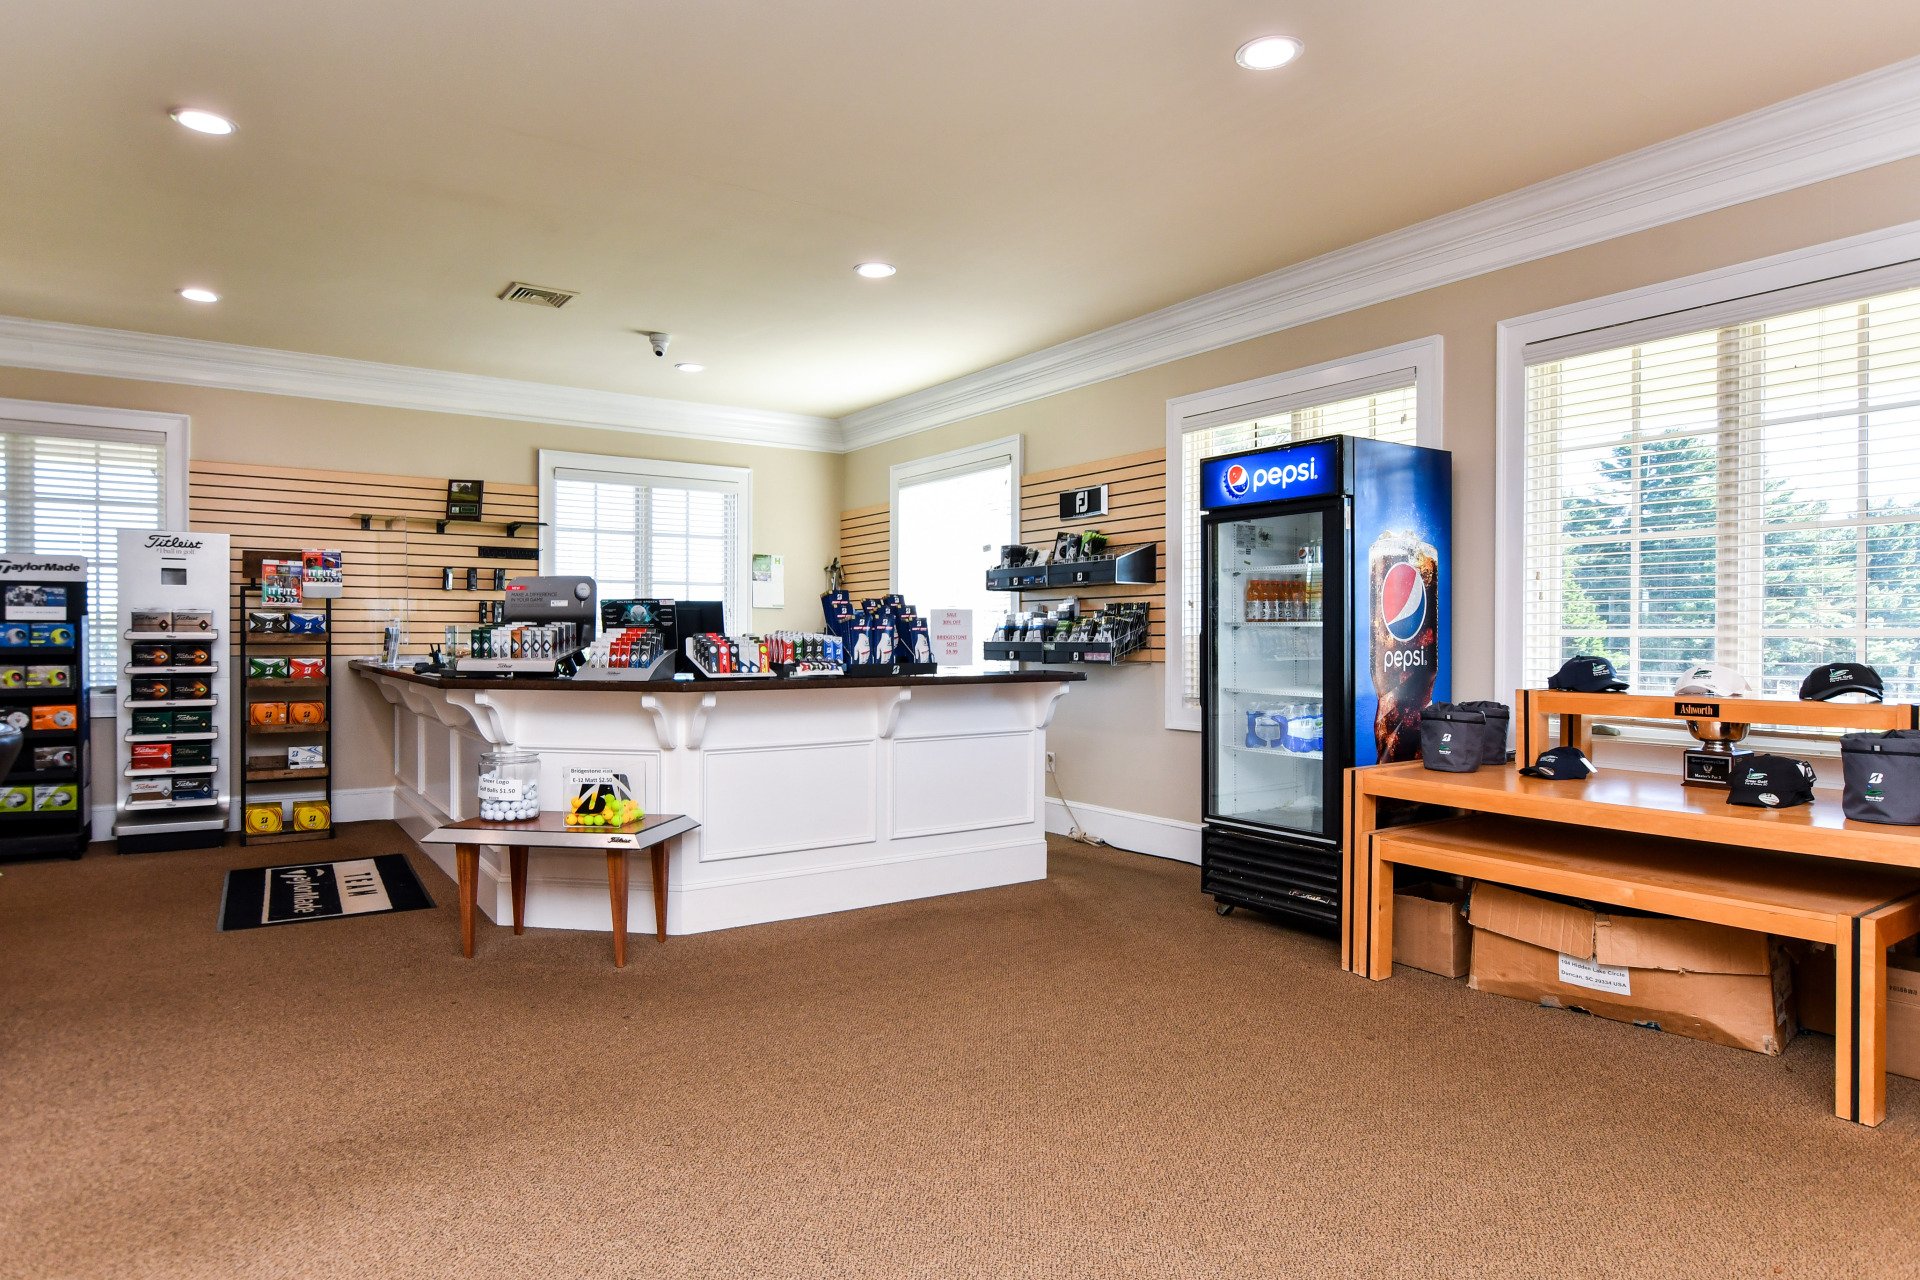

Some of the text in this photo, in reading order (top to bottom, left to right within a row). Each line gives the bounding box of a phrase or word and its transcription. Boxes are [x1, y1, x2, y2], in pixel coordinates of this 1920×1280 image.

[1253, 457, 1316, 493] pepsi
[144, 534, 204, 549] Titleist
[0, 559, 80, 574] TaylorMade
[318, 569, 336, 577] FITS
[268, 587, 297, 596] IT FITS
[1384, 645, 1424, 672] pepsi
[1680, 703, 1713, 715] Ashworth
[279, 868, 325, 914] TaylorMade
[1571, 961, 1592, 971] Hidden
[1592, 967, 1606, 975] Lake
[1607, 970, 1626, 978] Circle
[1585, 974, 1594, 982] SC
